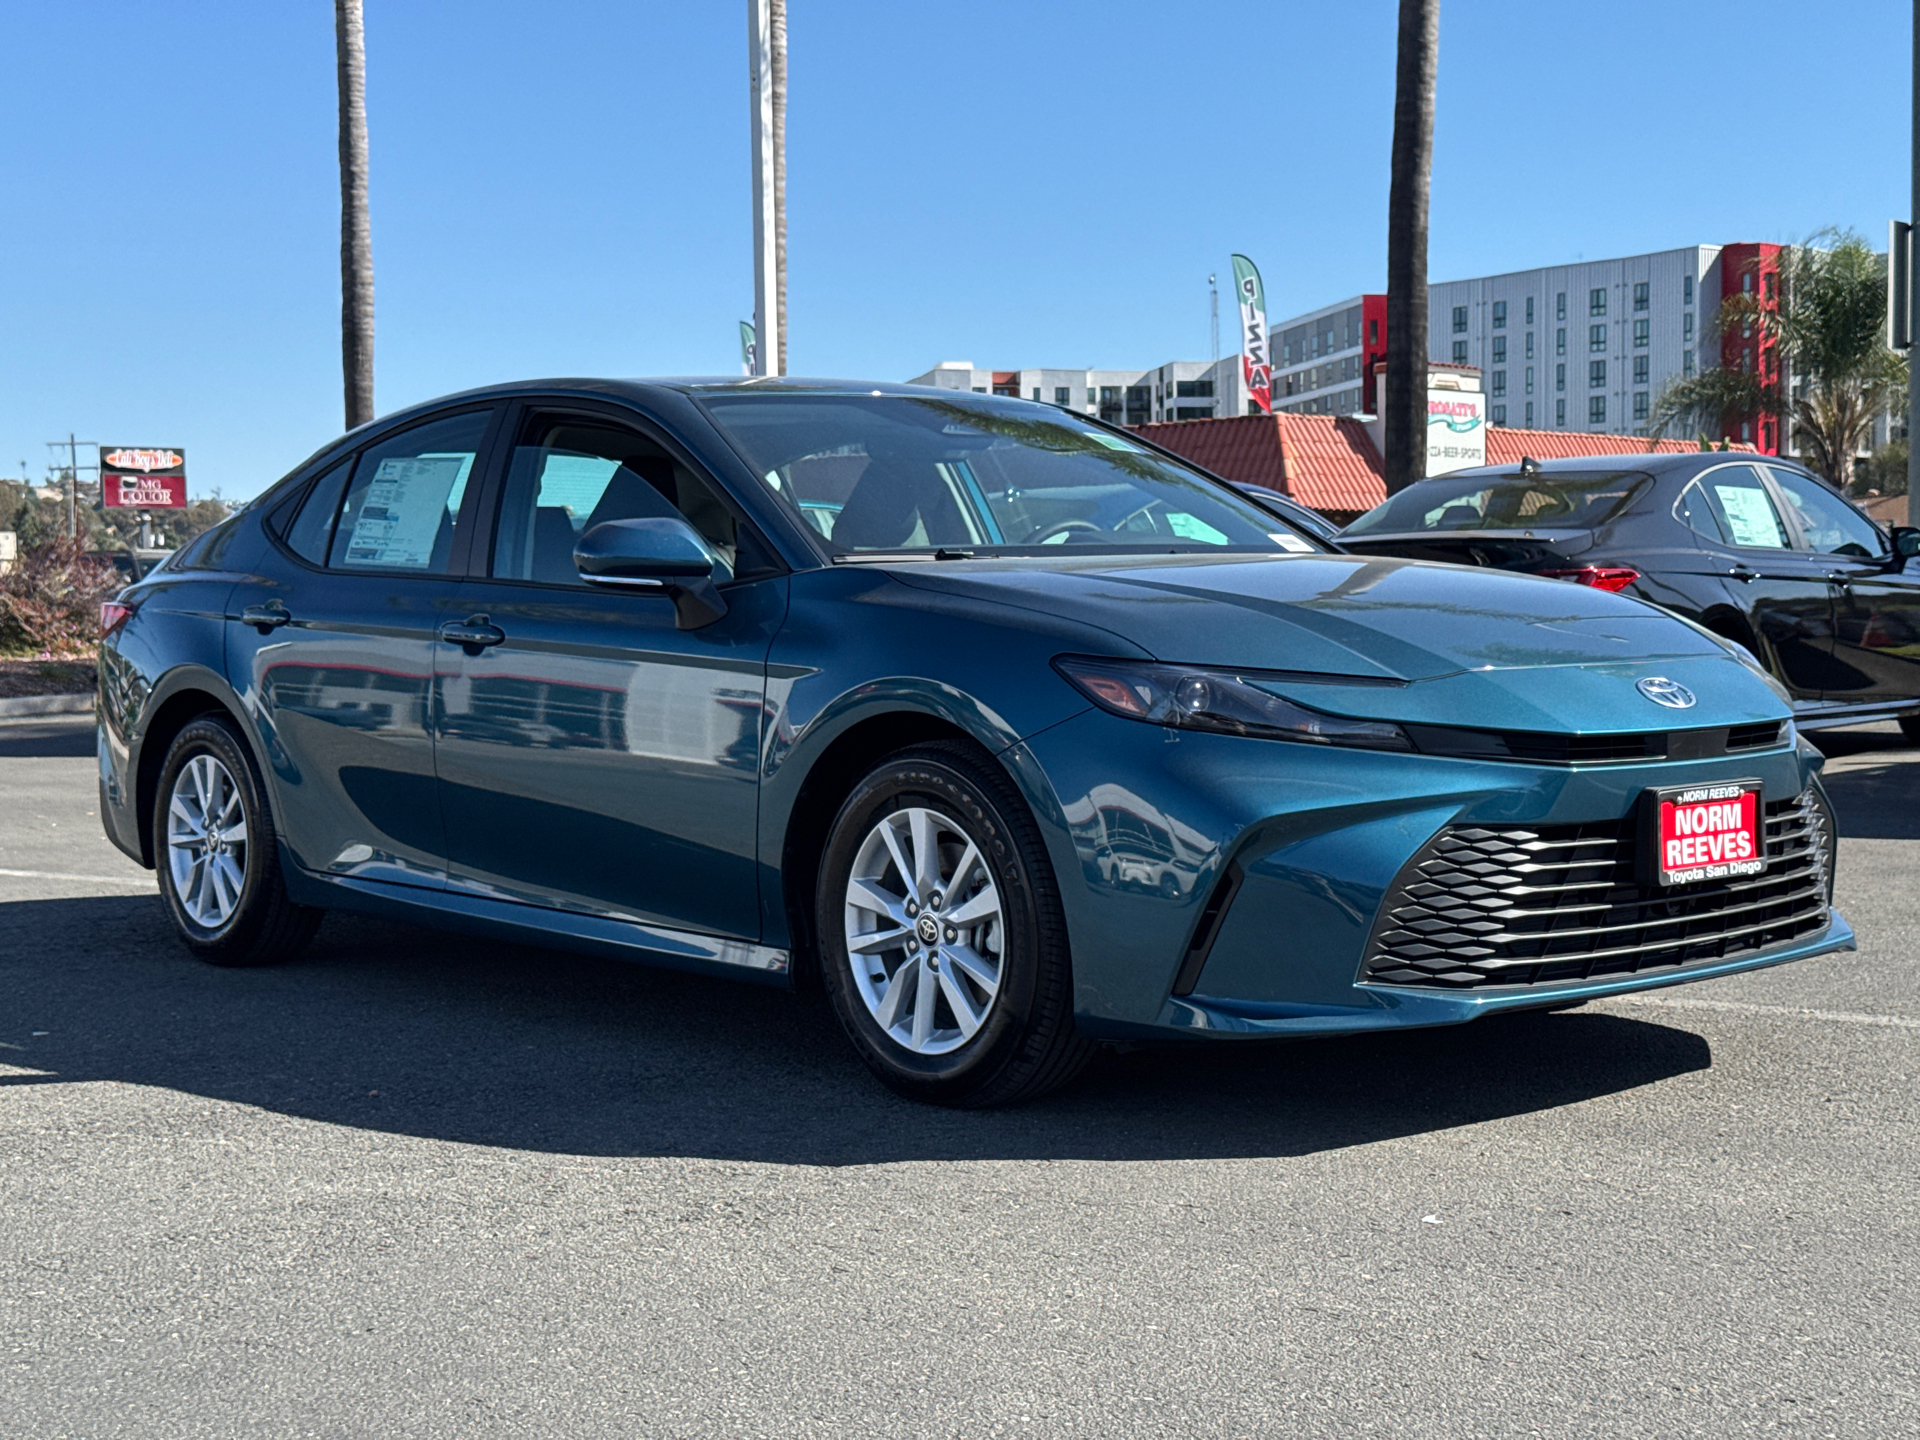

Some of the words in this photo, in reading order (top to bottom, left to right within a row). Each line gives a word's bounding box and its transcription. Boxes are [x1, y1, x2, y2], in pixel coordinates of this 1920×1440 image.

[141, 479, 161, 490] MG
[1683, 789, 1708, 803] NORM
[1709, 786, 1740, 799] REEVES
[1675, 803, 1742, 836] NORM
[1666, 831, 1752, 867] REEVES
[1667, 868, 1705, 884] Toyota
[1706, 865, 1728, 878] San
[1730, 861, 1762, 875] Diego
